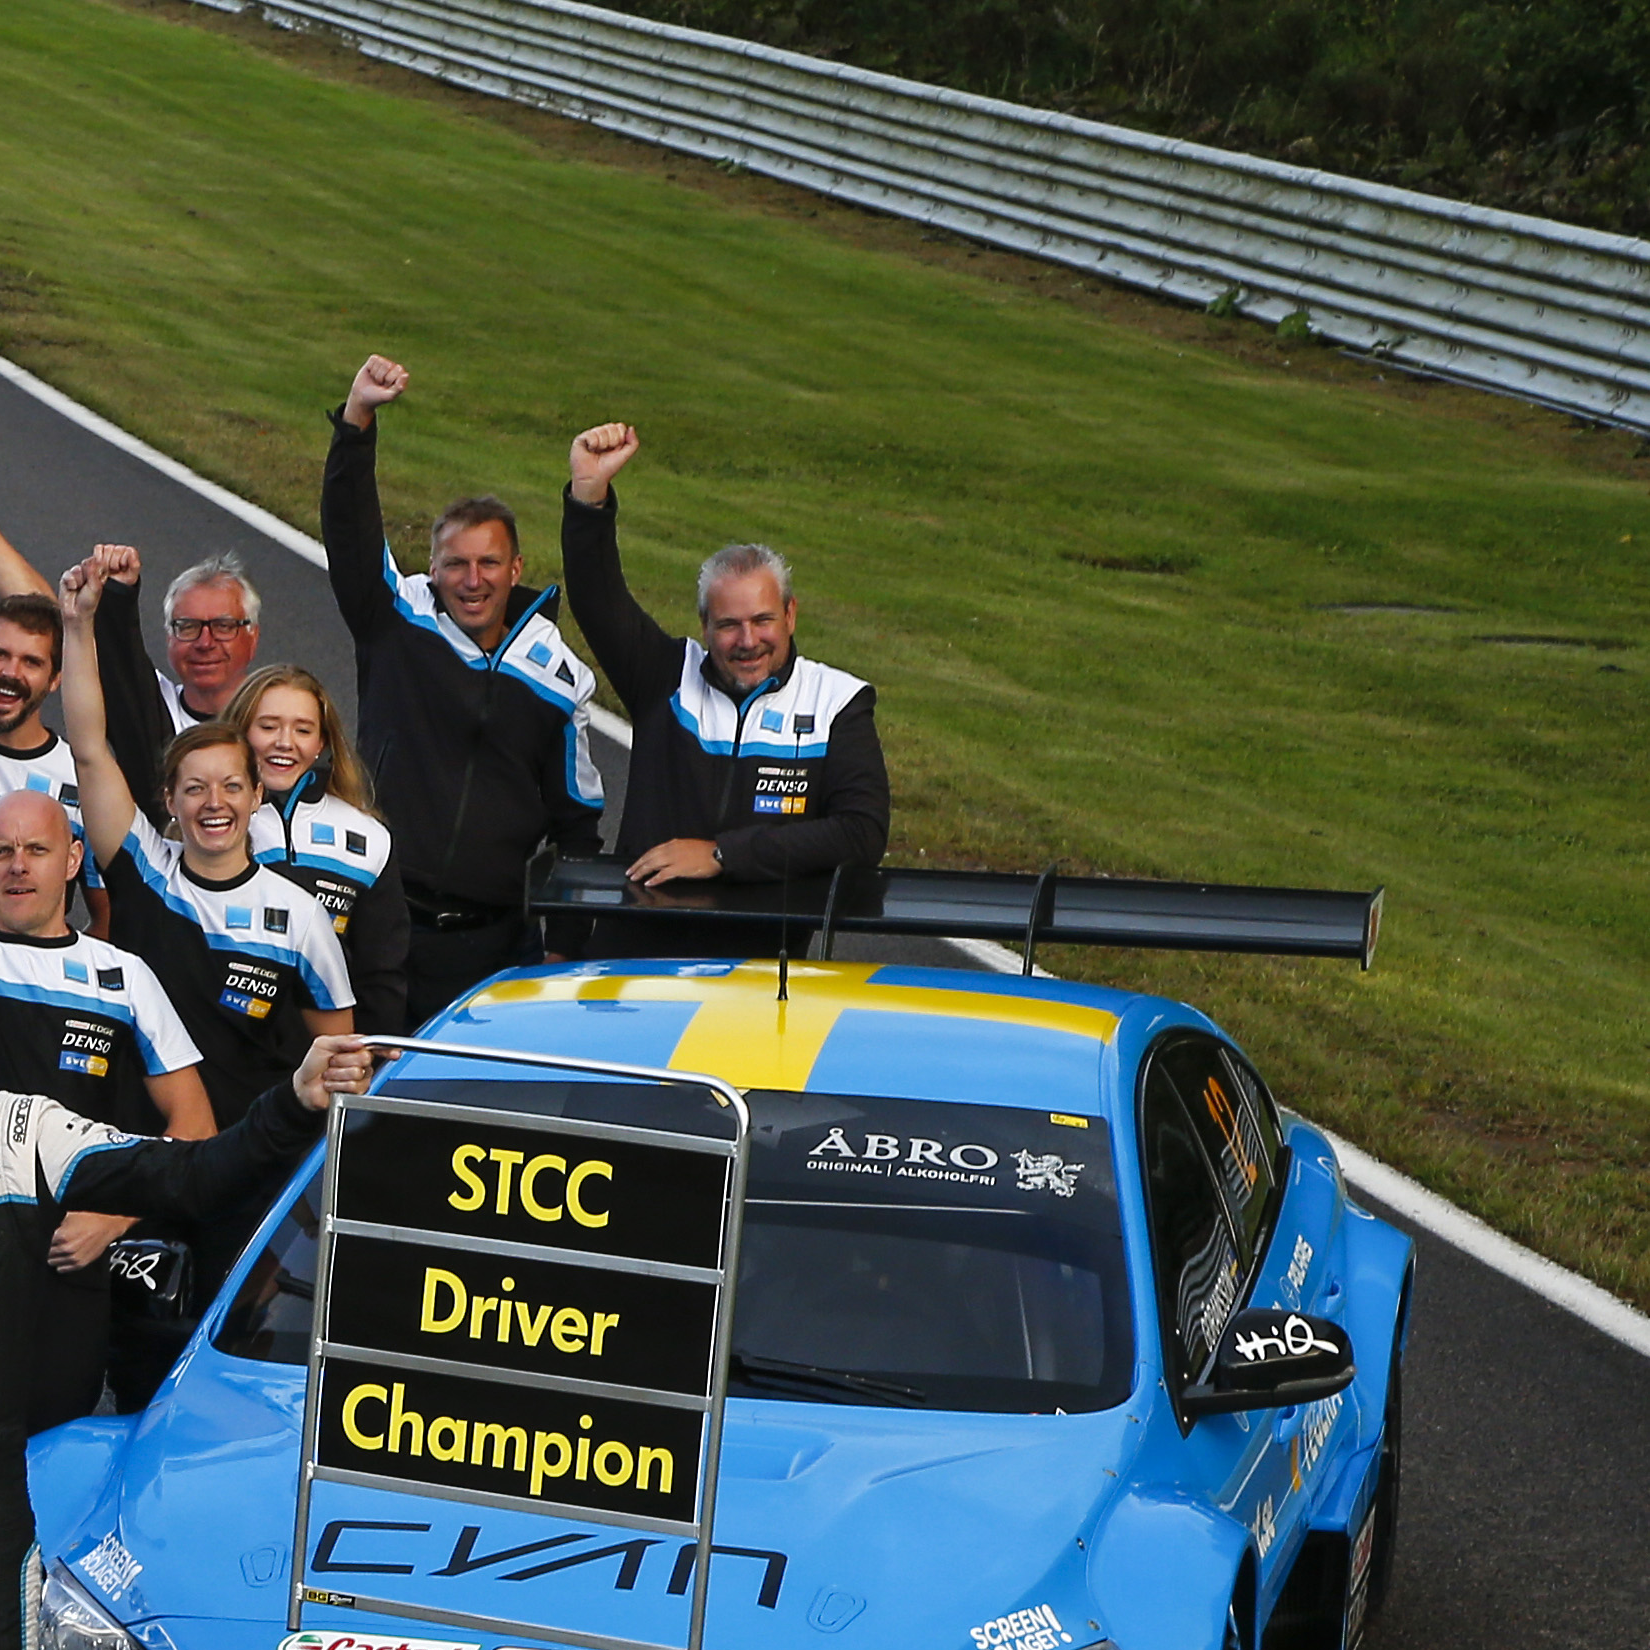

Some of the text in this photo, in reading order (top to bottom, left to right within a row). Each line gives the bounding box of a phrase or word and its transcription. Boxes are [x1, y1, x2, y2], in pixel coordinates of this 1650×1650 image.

[226, 974, 278, 998] DENSO
[62, 1033, 111, 1054] DENSO
[807, 1127, 999, 1172] ÅBRO
[447, 1143, 614, 1228] STCC
[806, 1159, 997, 1187] ORIGINAL ALKOHOLFRI
[419, 1266, 620, 1356] Driver
[1234, 1315, 1339, 1361] HiQ
[341, 1382, 674, 1496] Champion
[970, 1606, 1045, 1650] SCREEN
